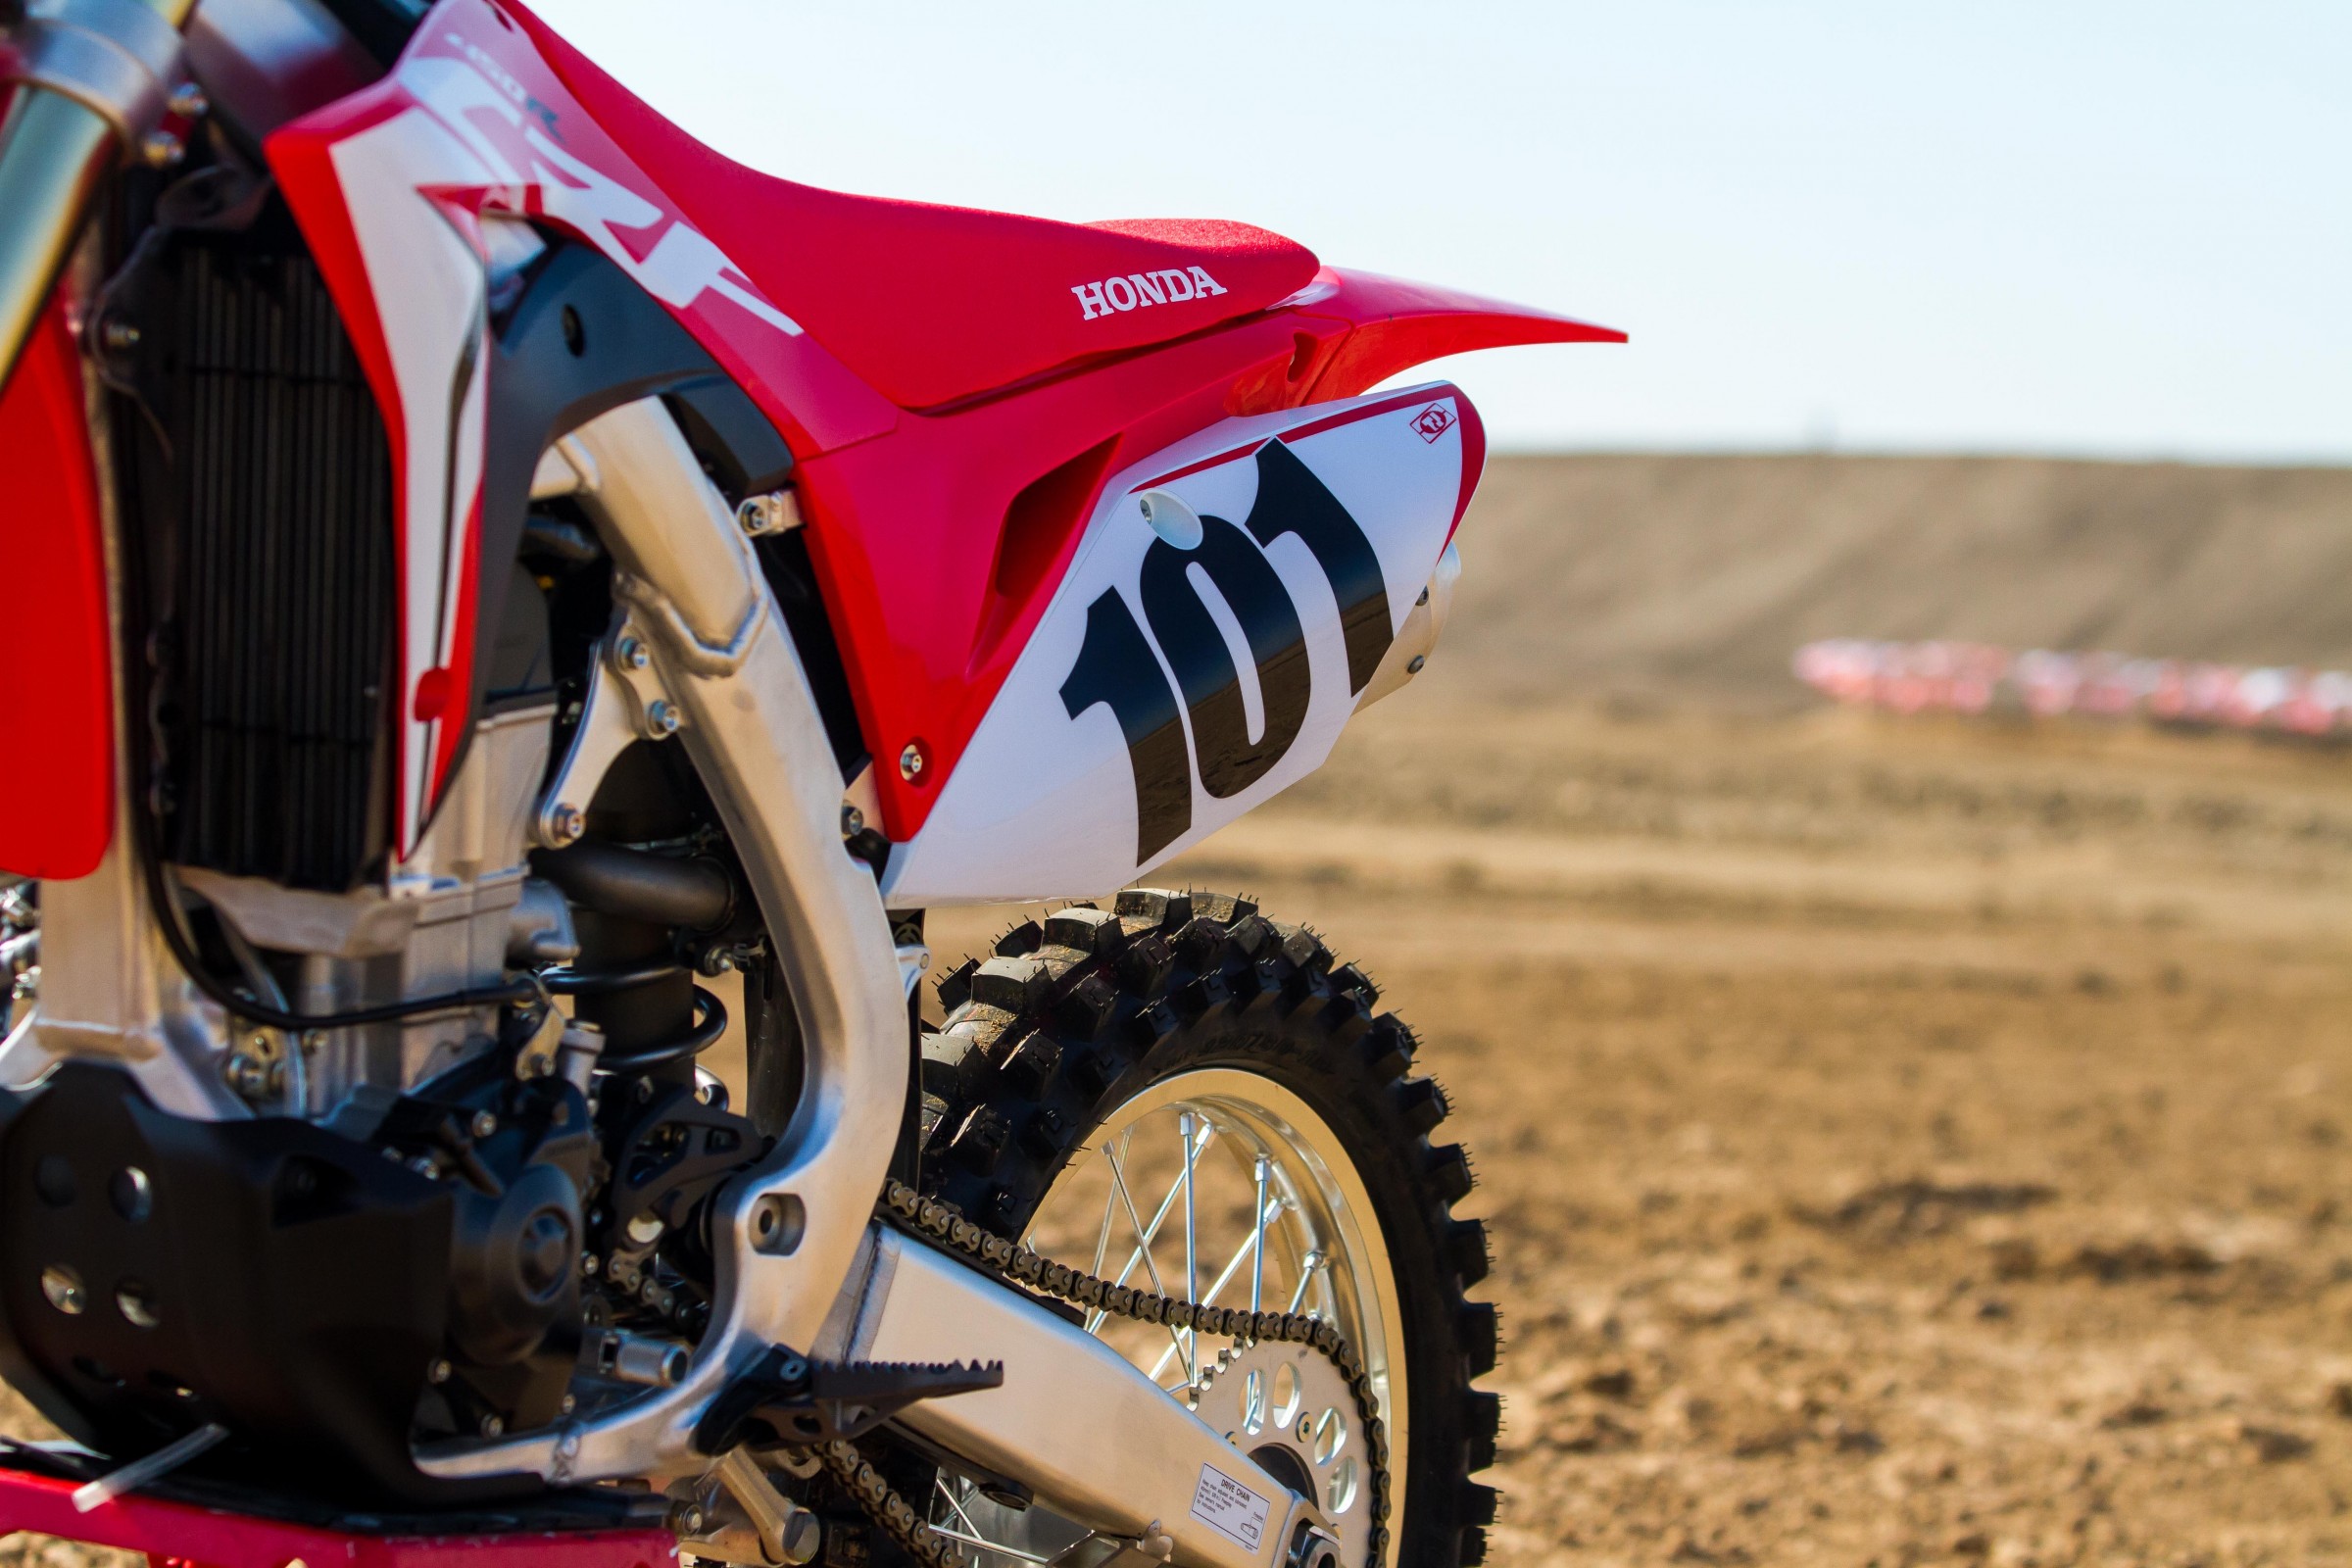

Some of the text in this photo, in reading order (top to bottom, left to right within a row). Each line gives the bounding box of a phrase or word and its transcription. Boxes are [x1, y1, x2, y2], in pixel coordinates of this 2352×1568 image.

[1071, 266, 1228, 320] HONDA
[1058, 437, 1394, 867] 101
[1221, 1479, 1235, 1493] DRIVE
[1237, 1489, 1250, 1502] CHAIN
